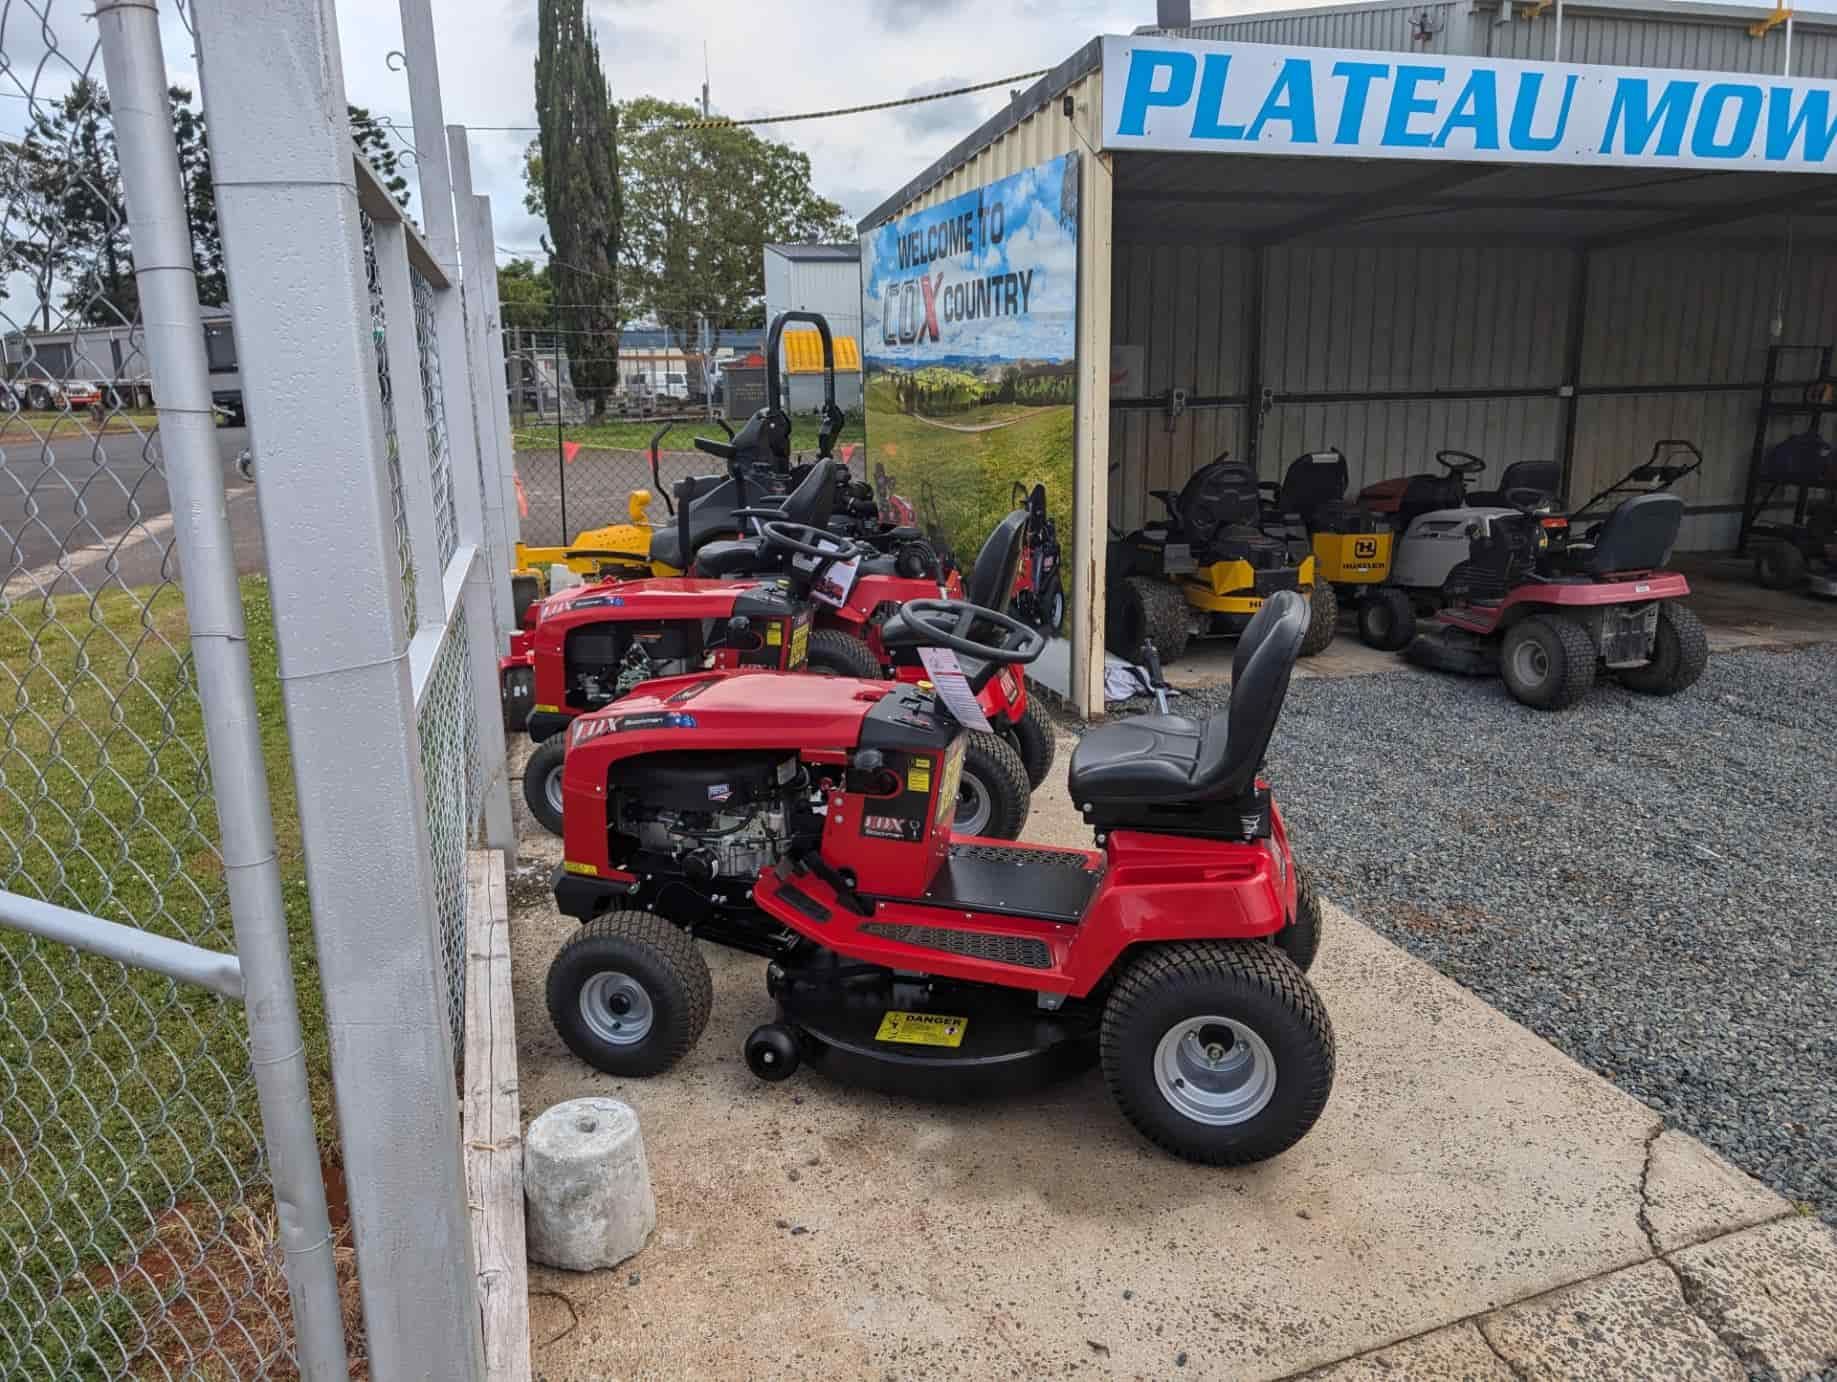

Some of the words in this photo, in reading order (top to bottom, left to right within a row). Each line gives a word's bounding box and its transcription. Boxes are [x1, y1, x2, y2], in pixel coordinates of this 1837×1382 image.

[1116, 48, 1578, 152] PLATEAU
[897, 211, 973, 270] WELCOME
[976, 202, 1005, 248] TO
[882, 271, 944, 346] COX
[944, 268, 1034, 322] COUNTRY
[905, 1014, 961, 1026] DANGER
